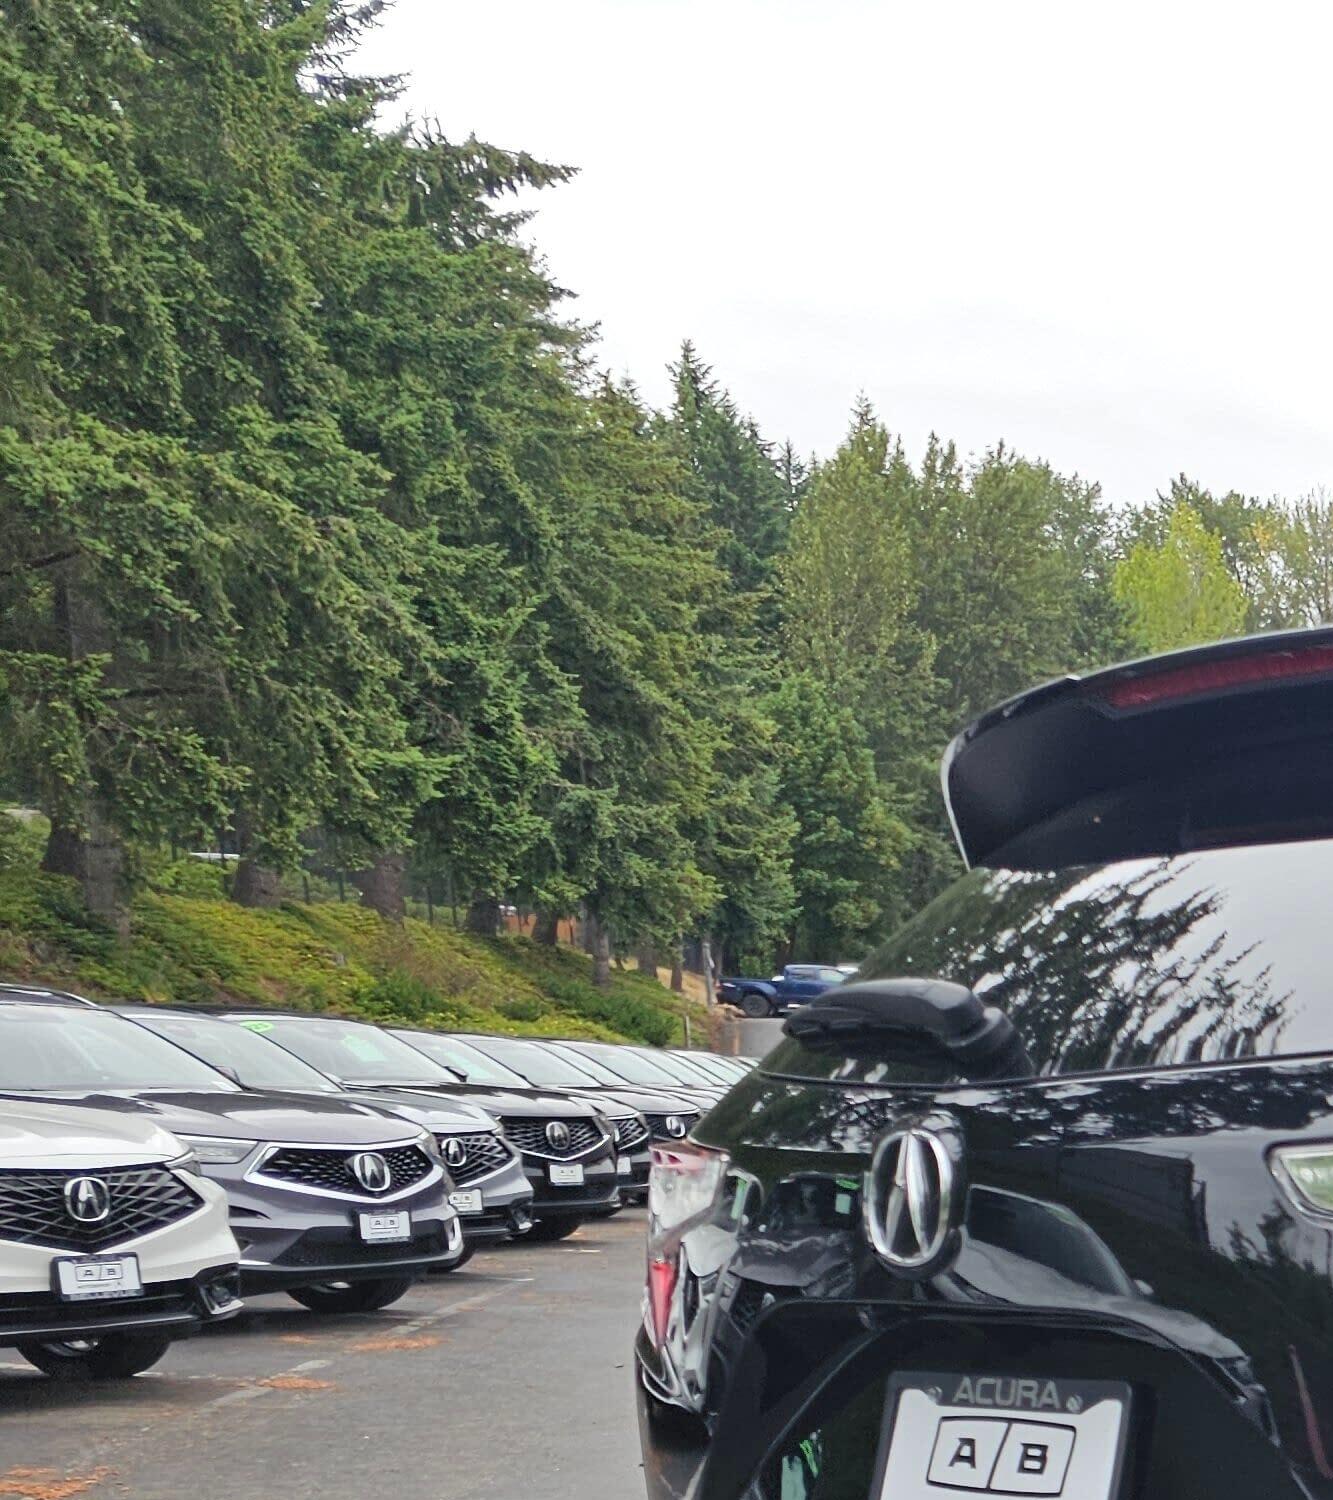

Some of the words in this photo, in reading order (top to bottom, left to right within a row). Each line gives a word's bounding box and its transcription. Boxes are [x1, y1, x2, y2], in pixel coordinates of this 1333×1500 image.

[951, 1376, 1061, 1410] ACURA
[948, 1437, 976, 1469] A
[1016, 1442, 1048, 1475] B
